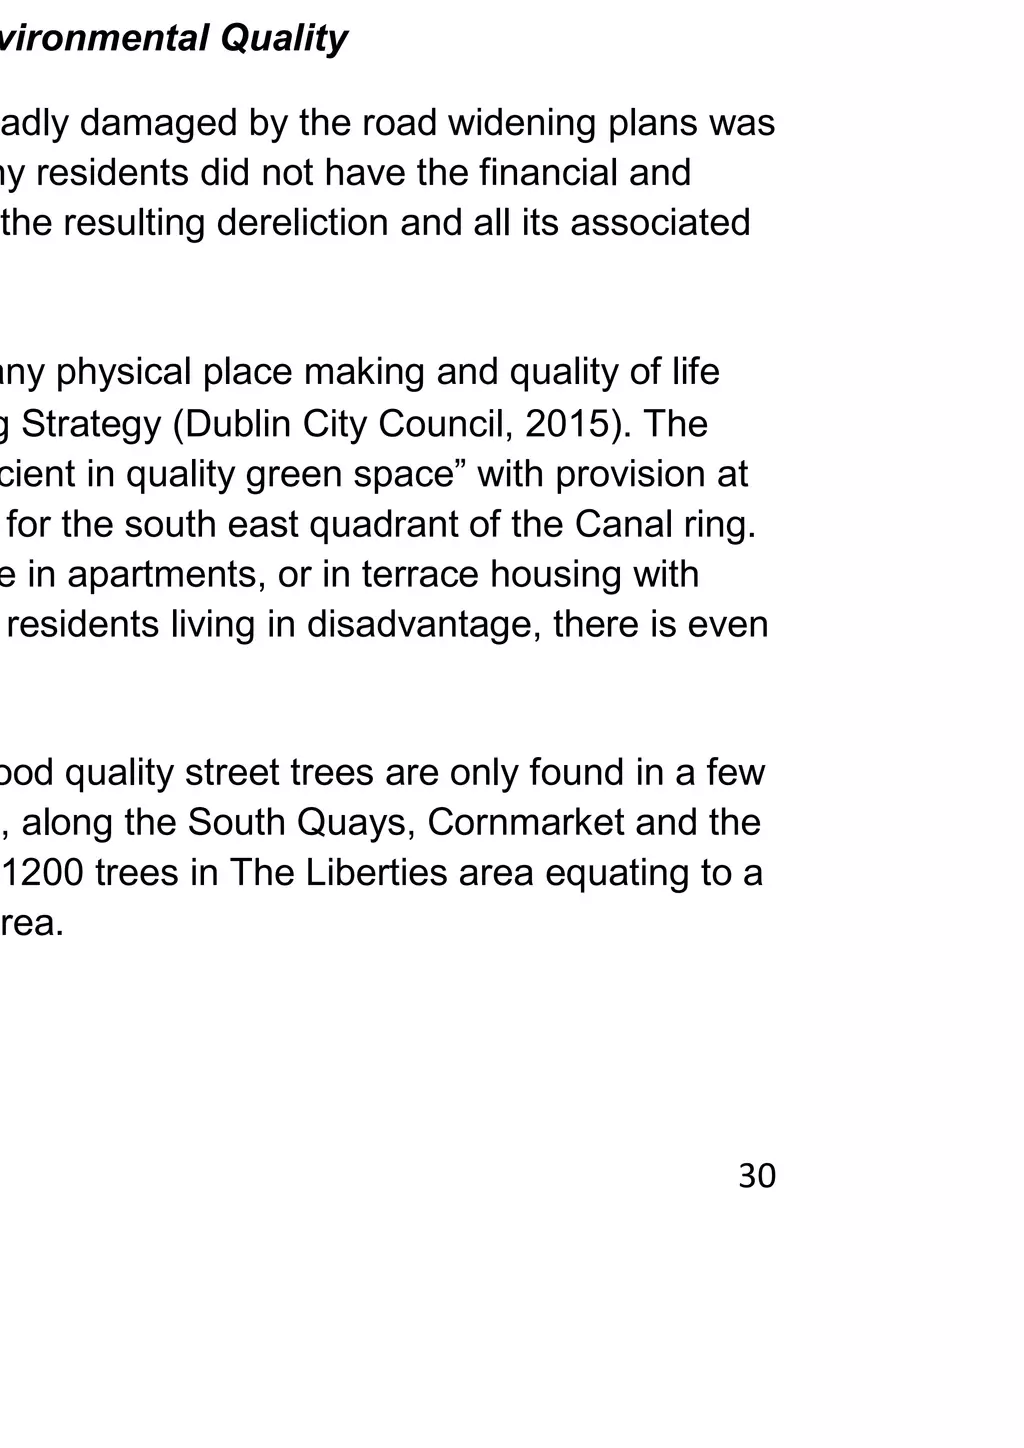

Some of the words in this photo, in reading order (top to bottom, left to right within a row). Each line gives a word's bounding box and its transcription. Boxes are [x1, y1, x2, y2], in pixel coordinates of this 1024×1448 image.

[221, 22, 350, 59] Quality
[80, 107, 237, 144] damaged
[250, 107, 289, 144] by
[299, 107, 351, 136] the
[363, 107, 436, 137] road
[447, 107, 595, 144] widening
[609, 107, 698, 144] plans
[708, 114, 776, 136] was
[37, 157, 189, 186] residents
[200, 157, 249, 186] did
[263, 158, 314, 186] not
[326, 157, 406, 186] have
[416, 157, 469, 186] the
[479, 156, 617, 186] financial
[629, 157, 690, 186] and
[0, 207, 52, 236] the
[65, 207, 205, 244] resulting
[217, 207, 388, 236] dereliction
[401, 207, 462, 236] and
[474, 207, 510, 236] all
[523, 207, 559, 236] its
[571, 207, 750, 236] associated
[22, 408, 162, 445] Strategy
[173, 408, 290, 445] (Dublin
[303, 408, 368, 445] City
[379, 408, 512, 443] Council,
[526, 408, 631, 445] 2015).
[643, 408, 708, 438] The
[65, 756, 175, 794] quality
[185, 758, 280, 786] street
[290, 758, 374, 786] trees
[385, 764, 439, 786] are
[450, 756, 520, 794] only
[529, 756, 623, 786] found
[637, 756, 663, 786] in
[675, 764, 695, 786] a
[706, 756, 766, 786] few
[22, 806, 112, 844] along
[124, 806, 177, 836] the
[188, 806, 285, 836] South
[297, 806, 414, 844] Quays,
[428, 806, 625, 836] Cornmarket
[636, 806, 697, 836] and
[708, 806, 761, 836] the
[739, 1162, 776, 1189] 30
